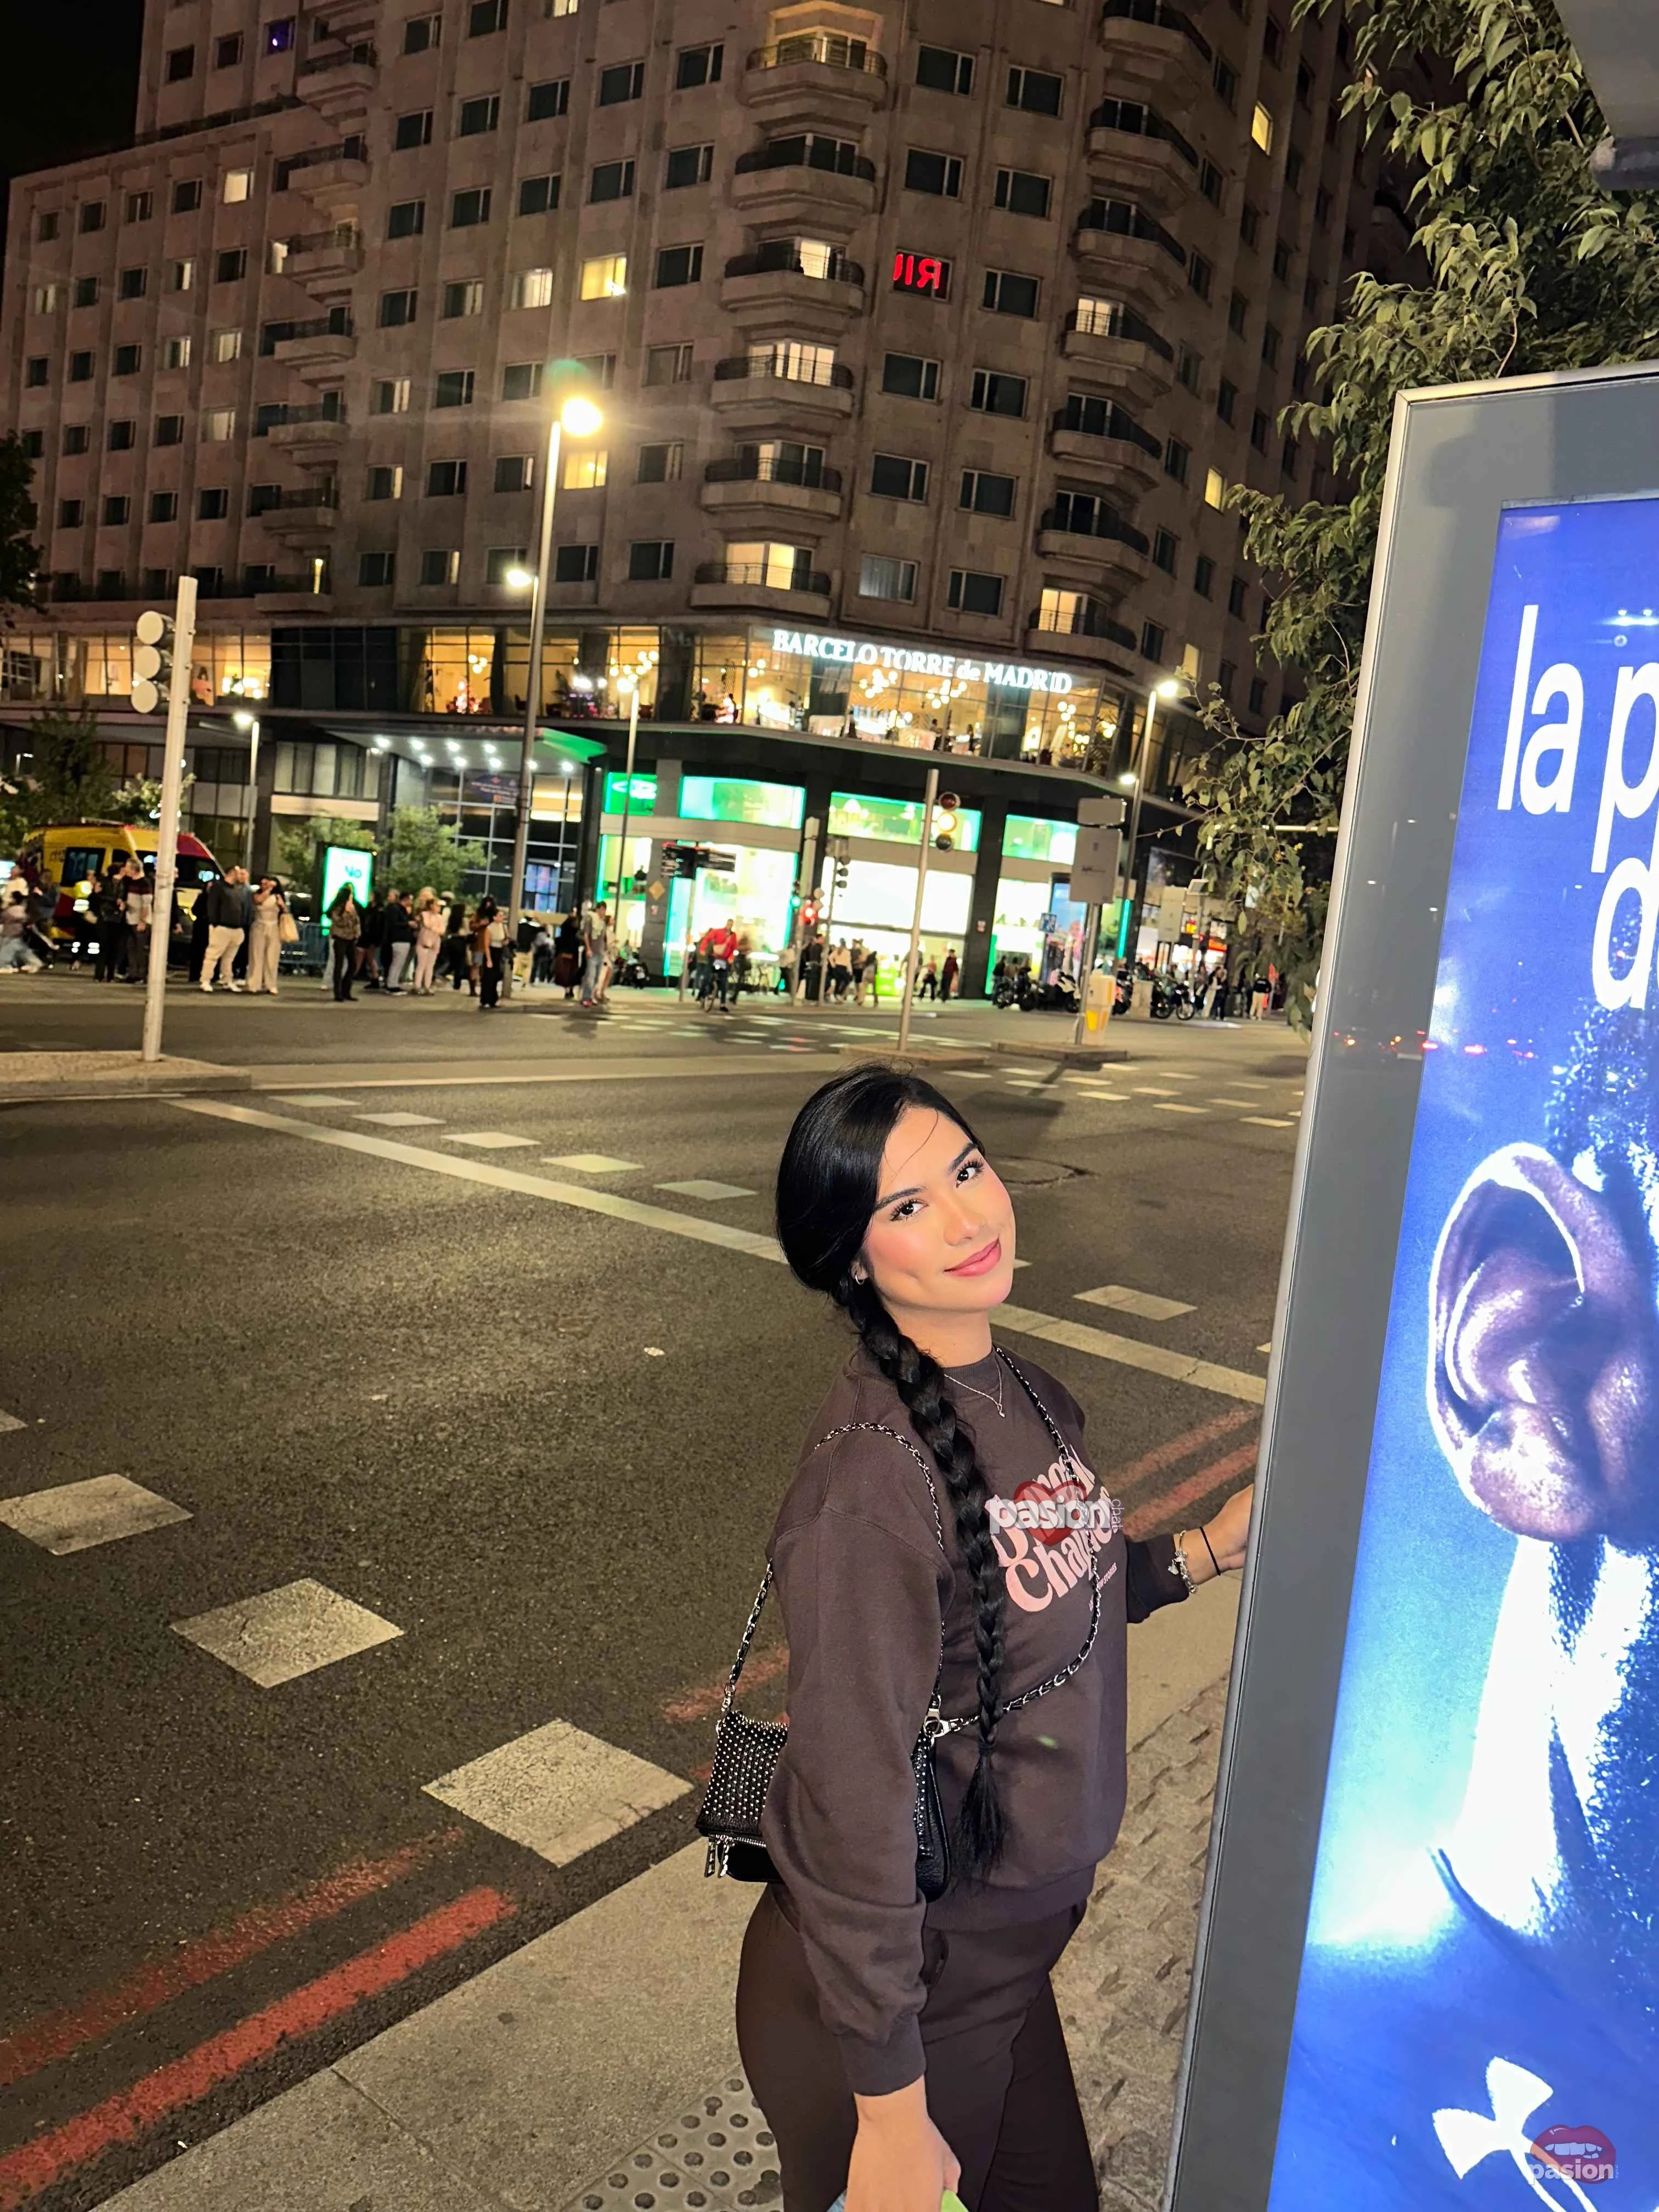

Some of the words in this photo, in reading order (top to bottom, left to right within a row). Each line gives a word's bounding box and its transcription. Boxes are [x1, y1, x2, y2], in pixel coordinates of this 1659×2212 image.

[772, 629, 878, 665] BARCELO
[880, 647, 955, 677] TORRE
[956, 660, 981, 681] de
[983, 662, 1072, 694] MADRID
[1498, 605, 1584, 816] la
[1592, 809, 1659, 1011] d
